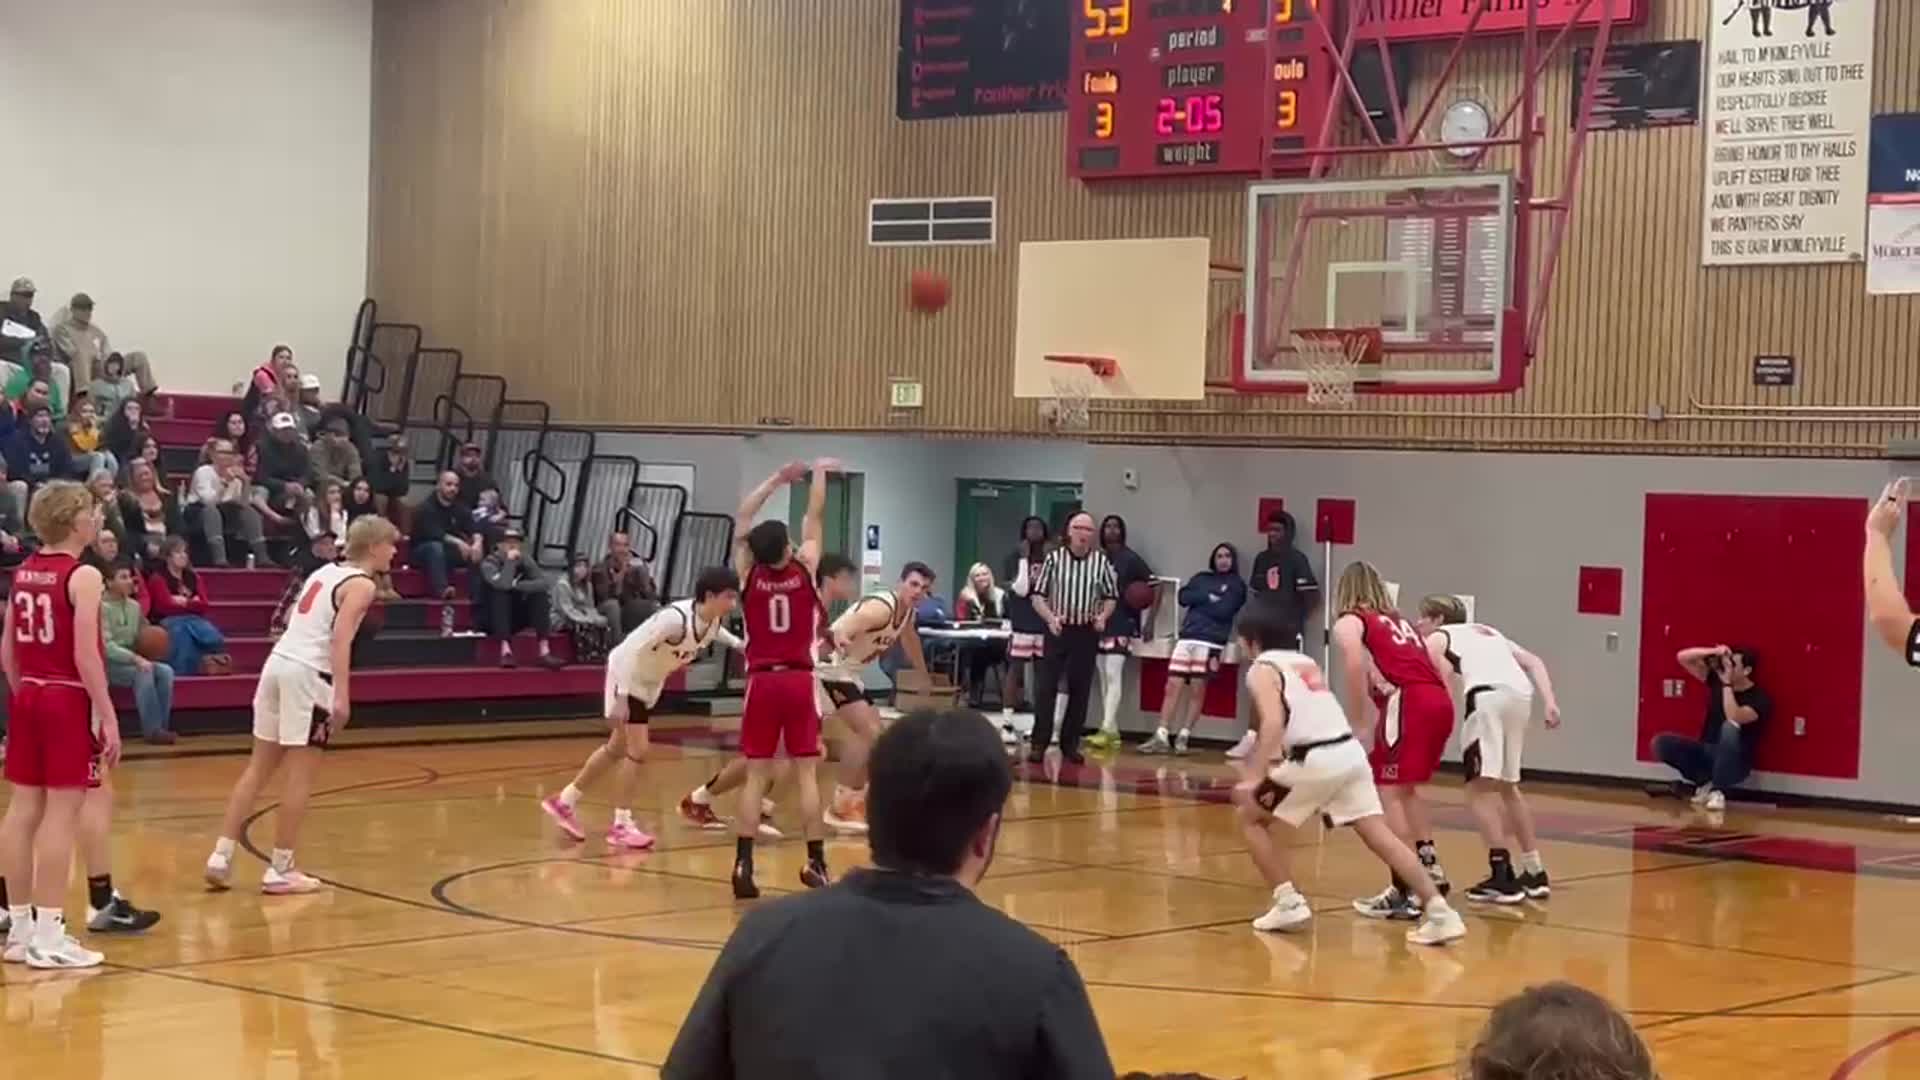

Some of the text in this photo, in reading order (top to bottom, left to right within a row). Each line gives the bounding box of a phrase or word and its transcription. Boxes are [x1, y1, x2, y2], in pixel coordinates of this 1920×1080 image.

[1168, 27, 1217, 52] period
[1718, 49, 1739, 65] HAIL
[1742, 48, 1756, 64] TO
[1168, 64, 1215, 87] player
[1274, 58, 1305, 80] ouls
[1716, 71, 1736, 88] OUR
[1738, 69, 1775, 87] HEARTS
[1803, 66, 1823, 83] OUT
[1825, 65, 1838, 82] TO
[1840, 63, 1865, 80] THEE
[1277, 90, 1297, 128] 3
[1716, 91, 1786, 111] RESPECTFULLY
[1095, 102, 1113, 138] 3
[1745, 115, 1778, 133] SERVE
[1781, 114, 1806, 131] THEE
[1809, 112, 1835, 129] WELL
[1163, 141, 1211, 165] weight
[1713, 141, 1857, 162] BRING HONOR TO THY HALLS
[1712, 165, 1841, 186] UPLIFT ESTEEM FOR THEE
[1711, 189, 1840, 210] AND WITH GREAT DIGNITY
[1711, 213, 1805, 233] WE PANTHERS SAY
[1711, 239, 1732, 256] THIS
[1735, 239, 1746, 255] IS
[1747, 238, 1769, 255] OUR
[15, 591, 55, 645] 33
[769, 594, 791, 633] 0
[1377, 614, 1422, 649] 34
